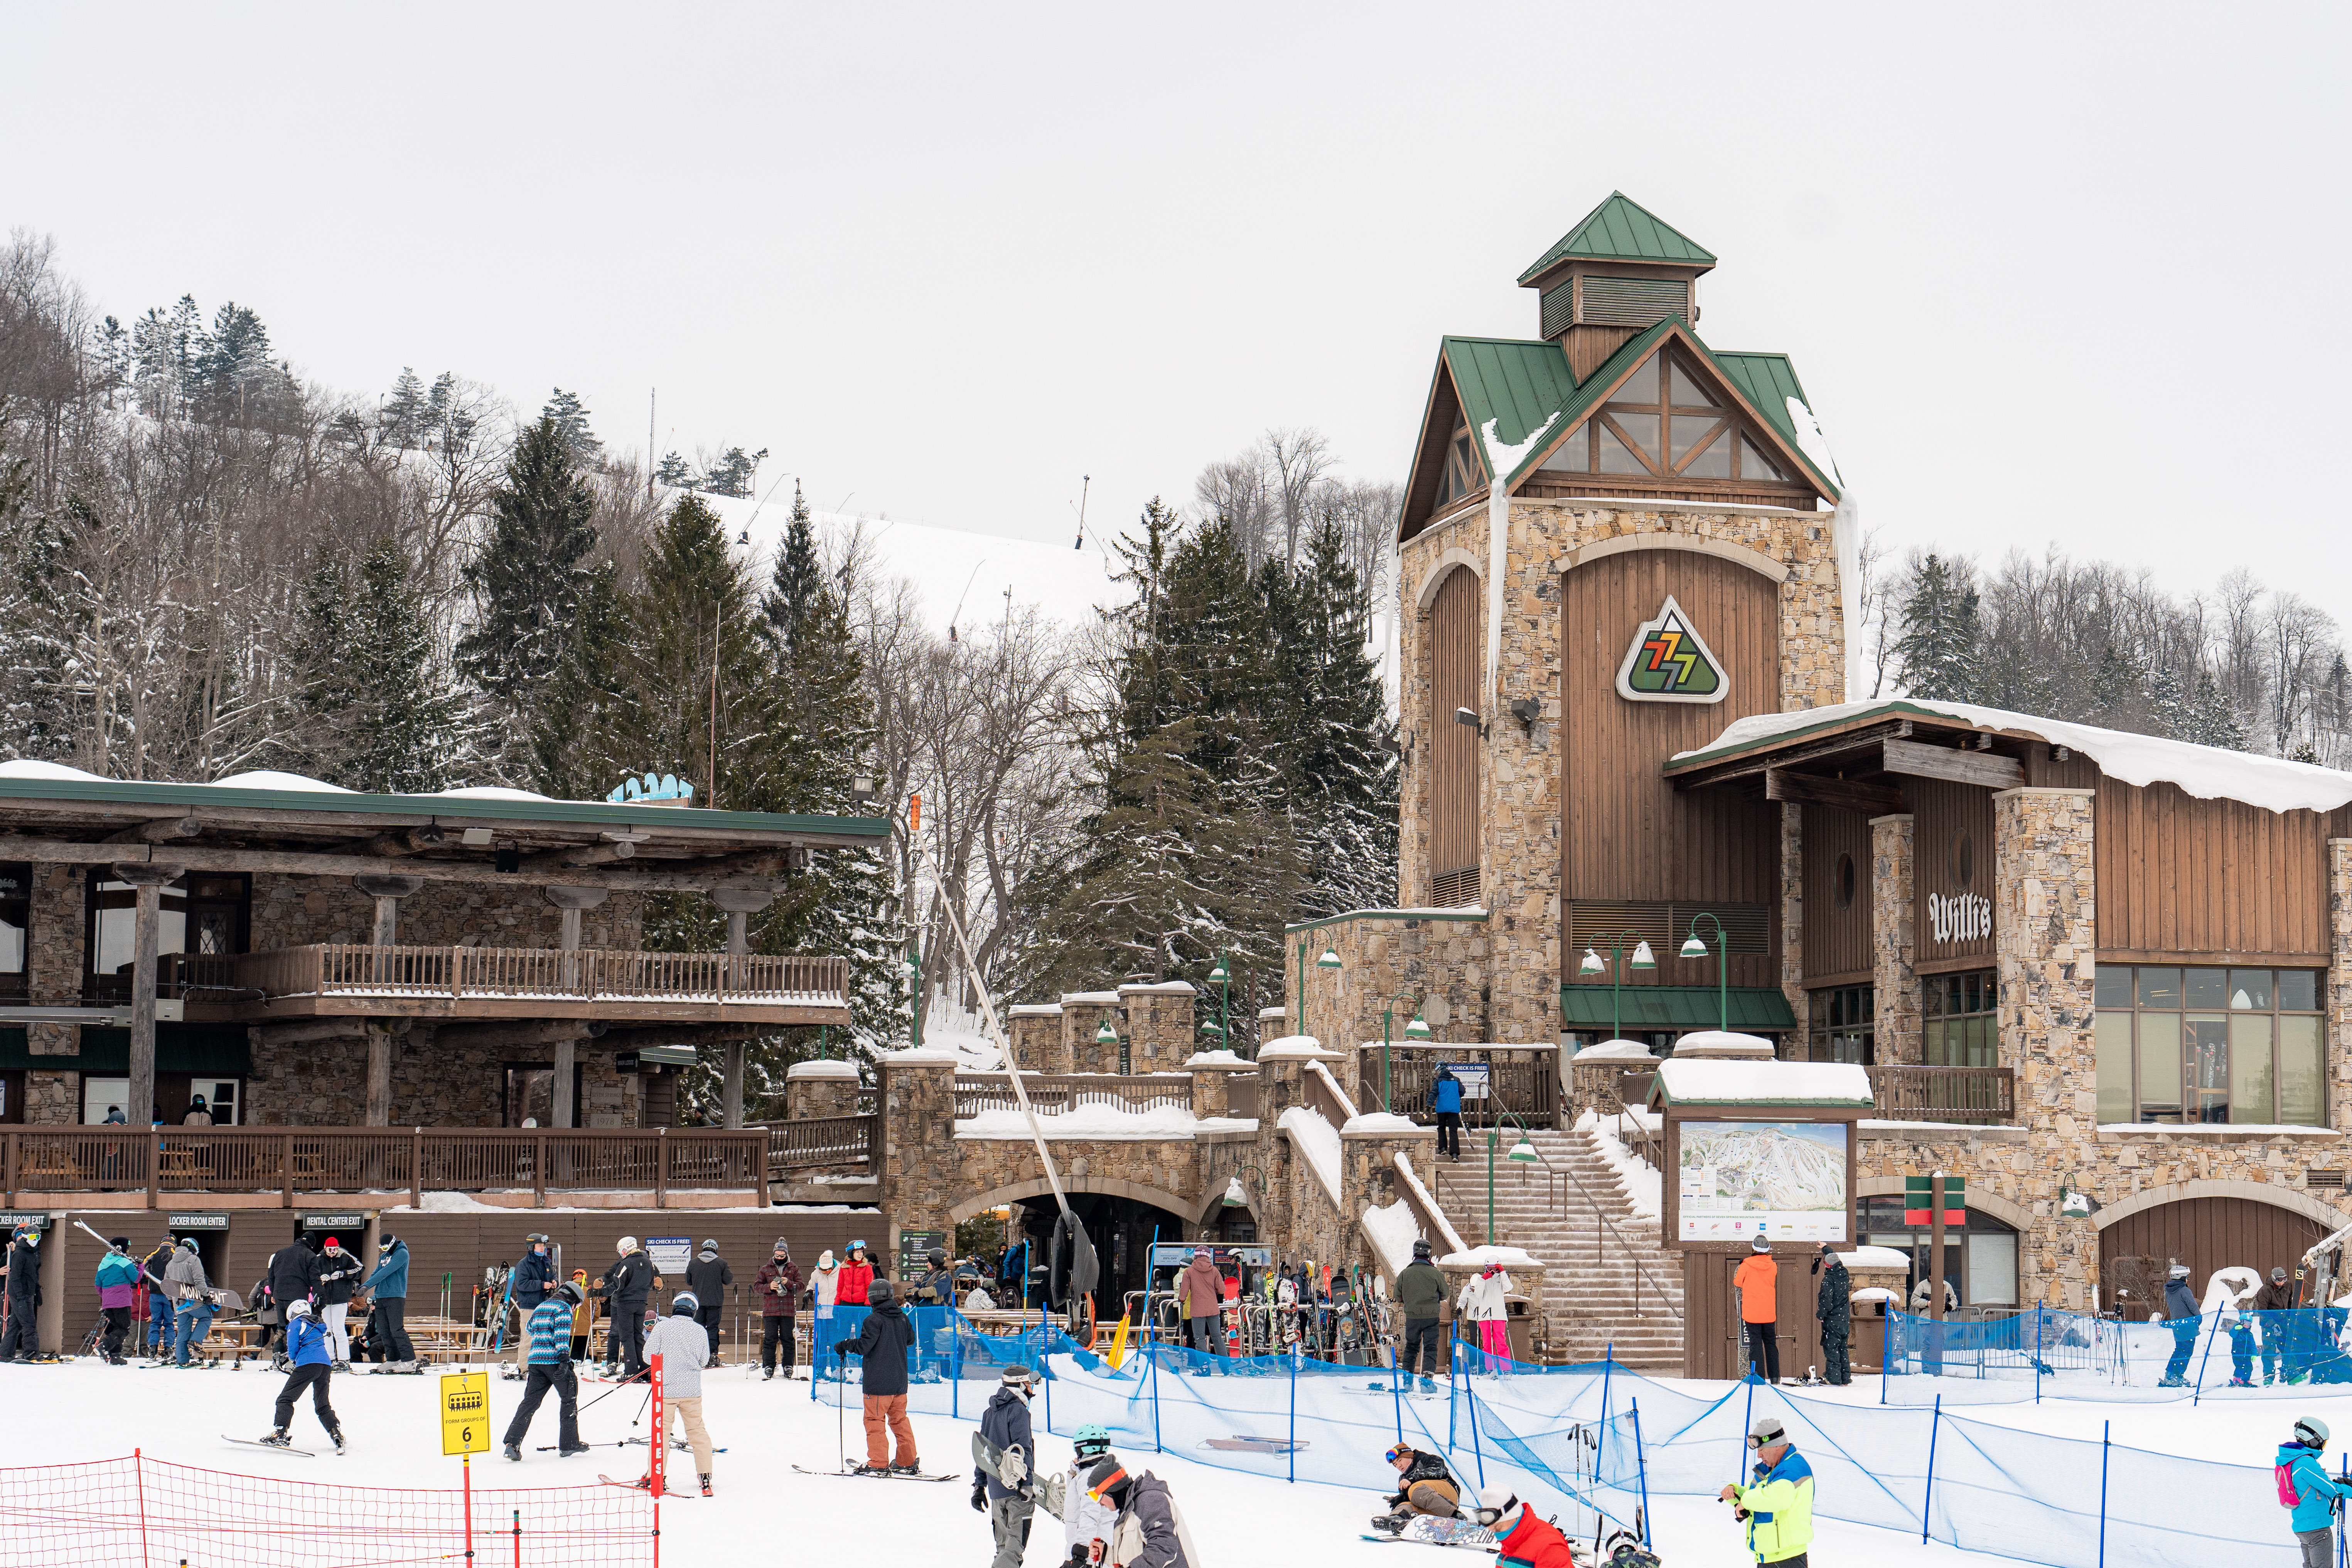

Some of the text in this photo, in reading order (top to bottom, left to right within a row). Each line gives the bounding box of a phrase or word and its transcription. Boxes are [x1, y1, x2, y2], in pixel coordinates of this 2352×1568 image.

[1929, 892, 1991, 944] Willi's
[13, 1216, 30, 1224] ROOM
[32, 1216, 44, 1224] EXIT
[169, 1217, 226, 1226] LOCKER ROOM ENTER
[307, 1217, 360, 1226] RENTAL CENTER EXIT
[180, 1282, 228, 1304] MONUENT
[463, 1427, 472, 1442] 6
[1476, 1529, 1495, 1543] LIB
